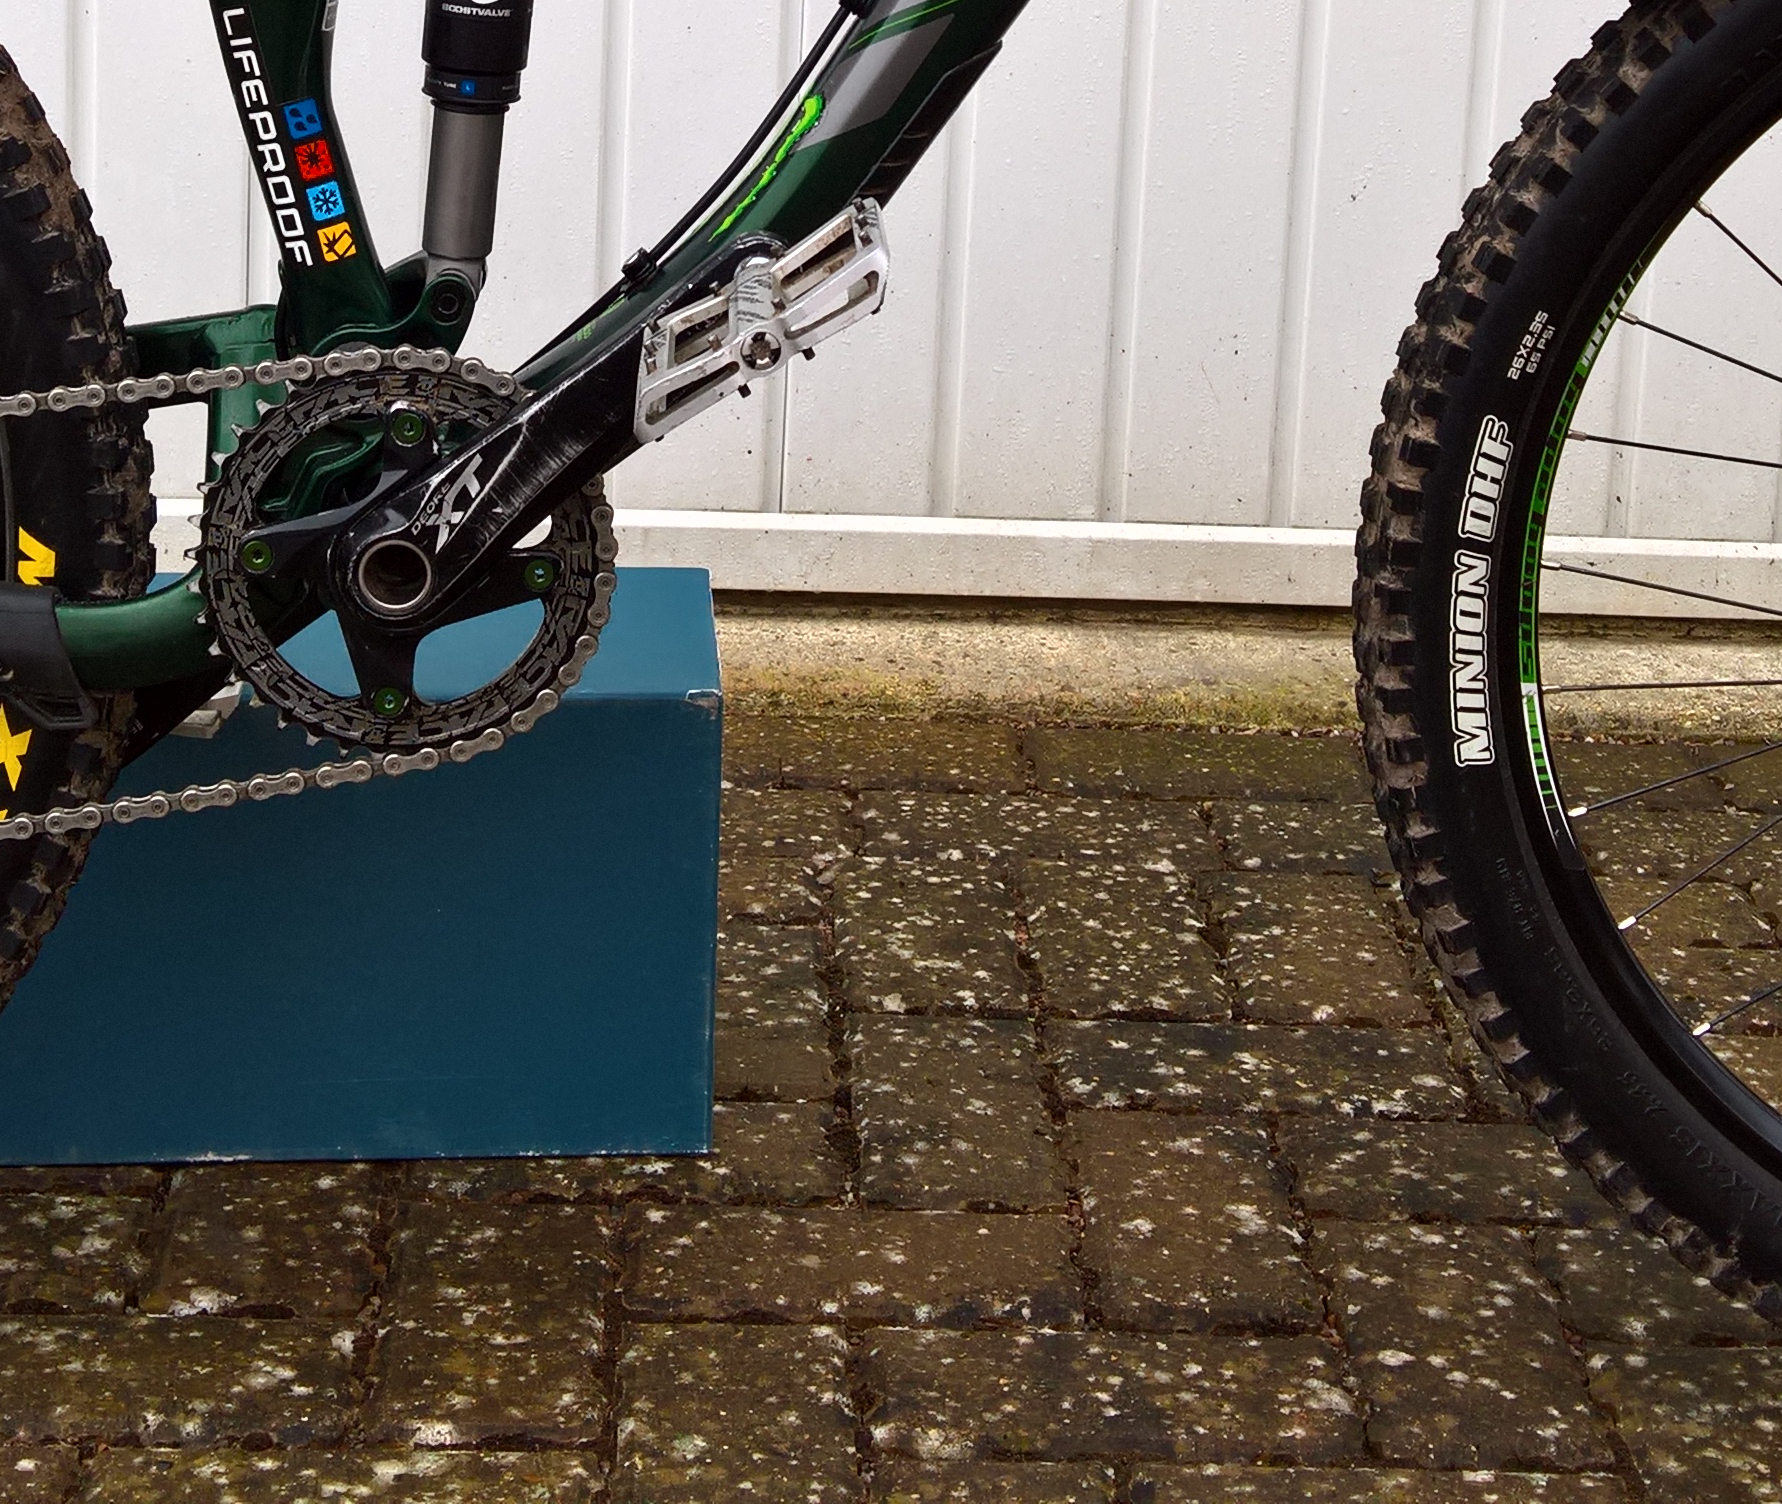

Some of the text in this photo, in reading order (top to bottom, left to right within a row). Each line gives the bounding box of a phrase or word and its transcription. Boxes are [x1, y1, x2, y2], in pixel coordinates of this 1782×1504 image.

[222, 7, 314, 267] LIFEPROOF
[1507, 309, 1549, 380] 26X2.35
[1533, 325, 1556, 352] PSI
[411, 482, 450, 536] DEORE
[429, 454, 483, 554] XT
[1449, 414, 1515, 767] MINION DHF
